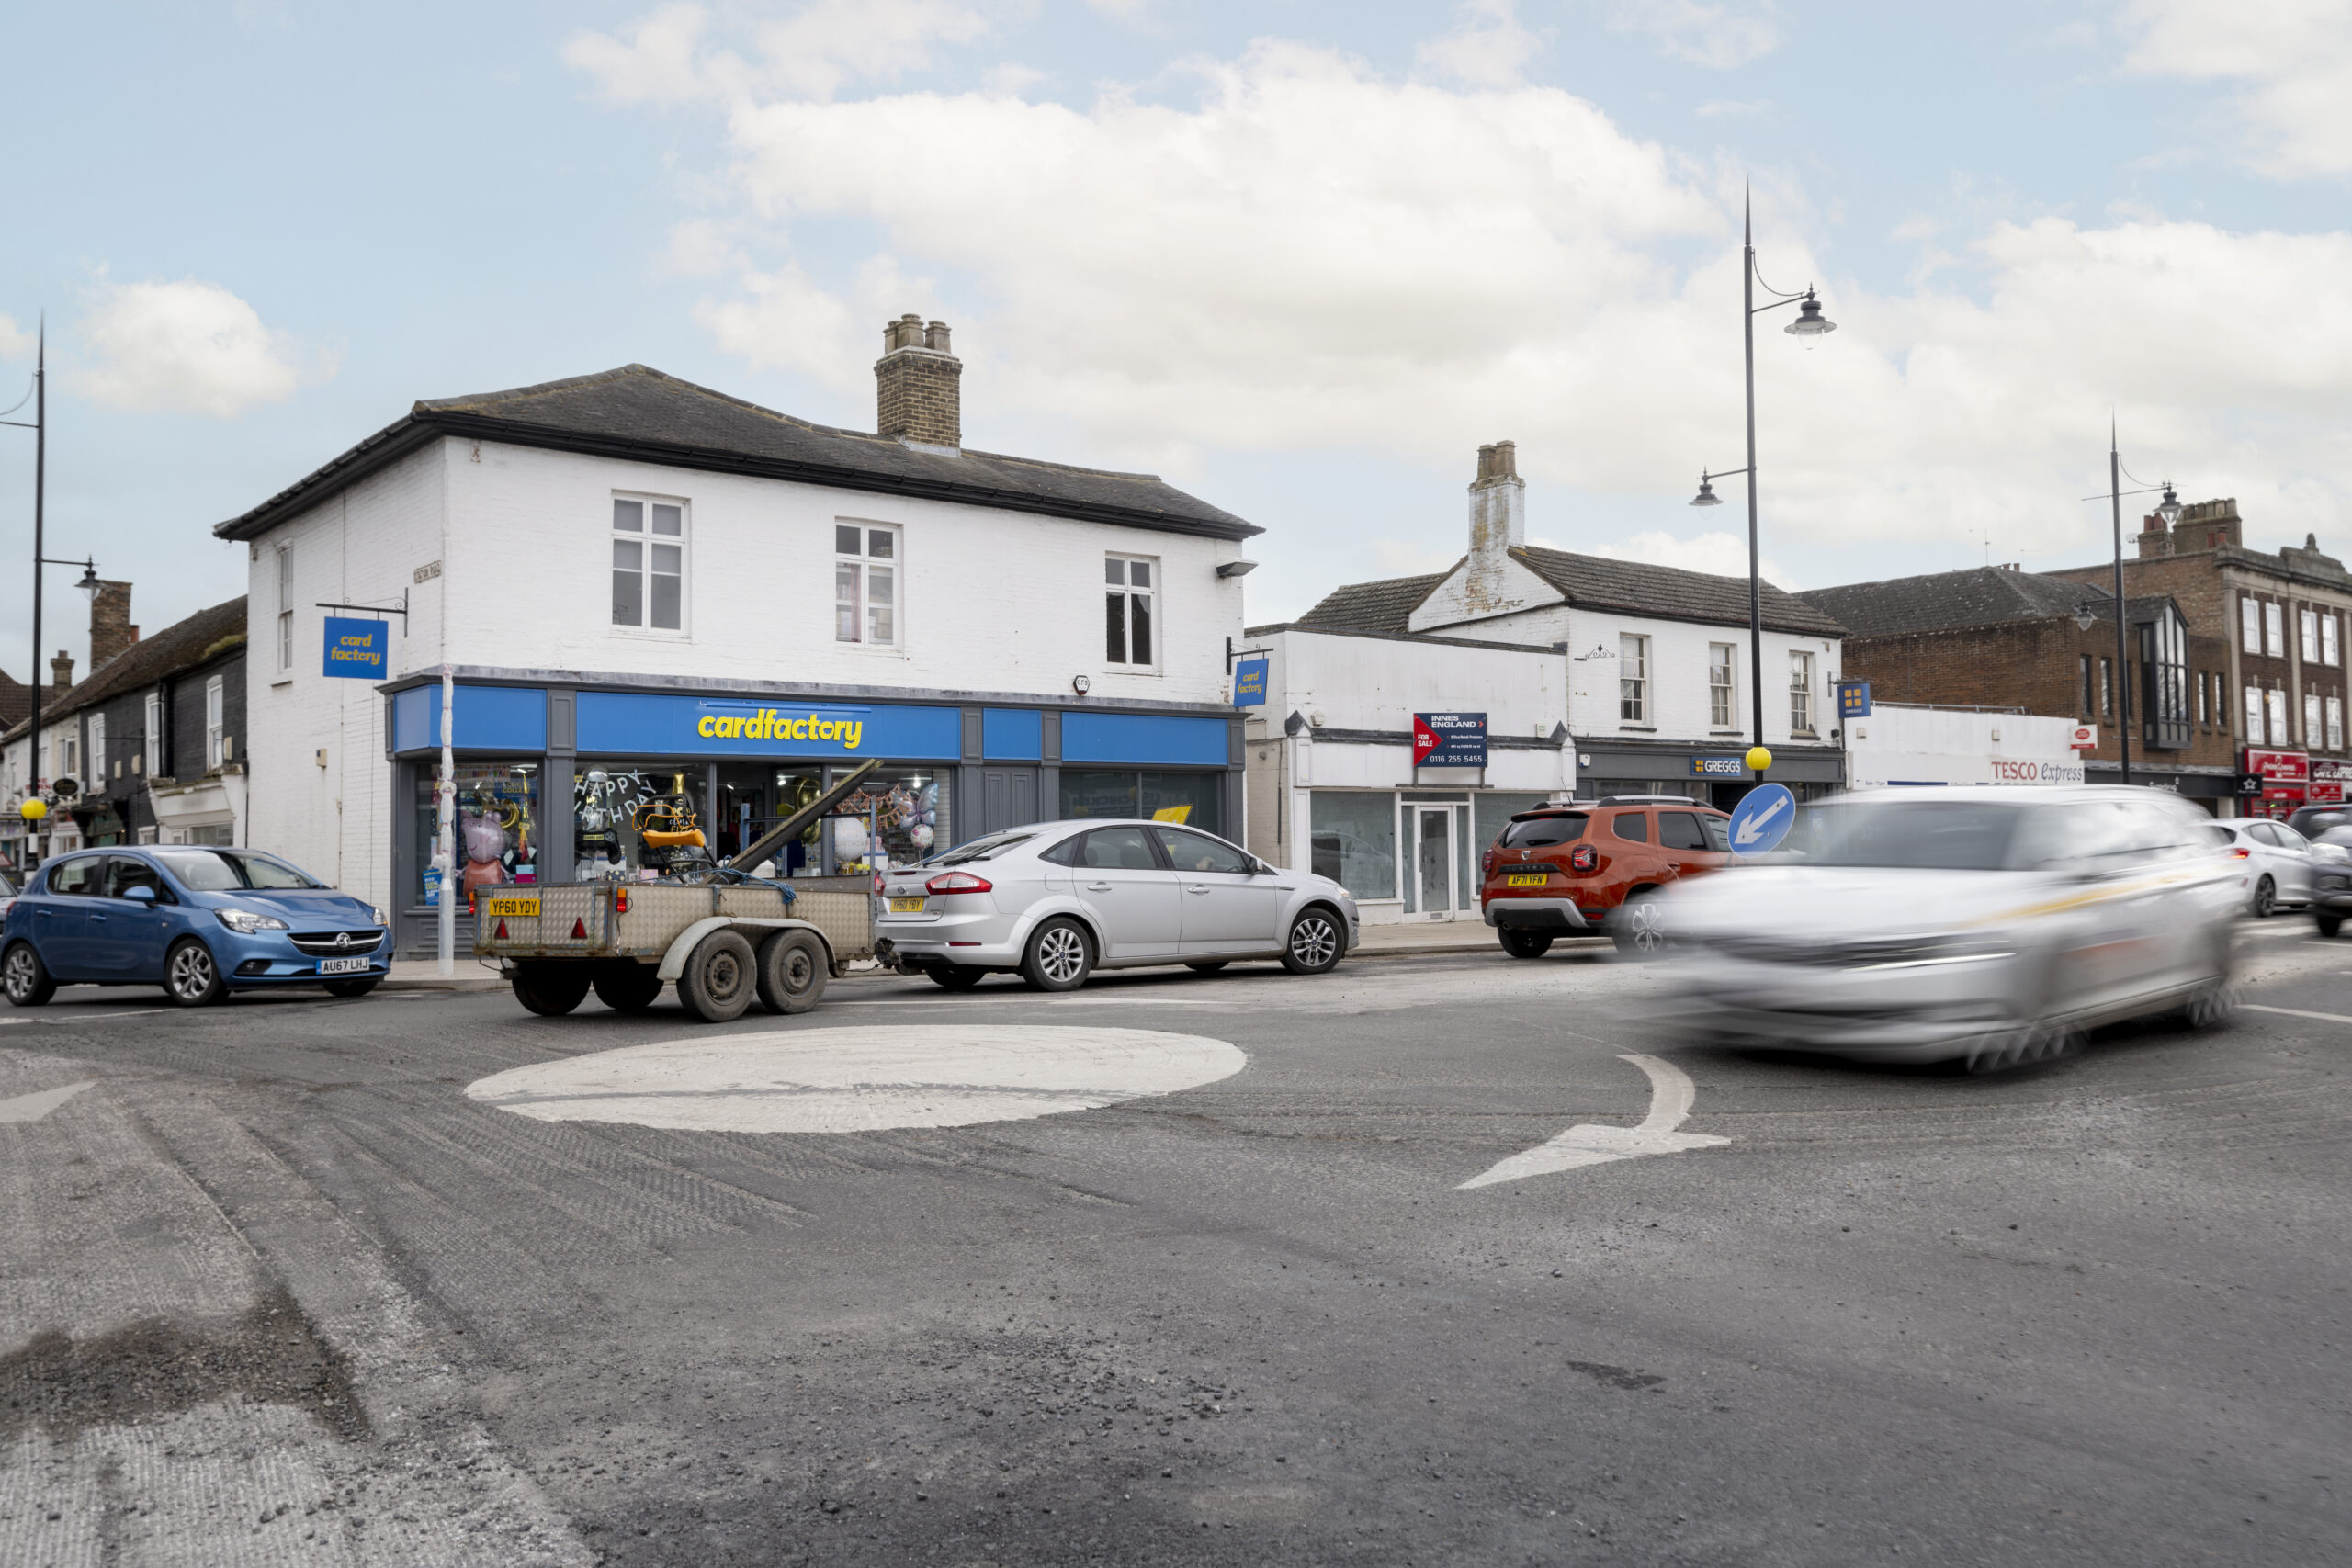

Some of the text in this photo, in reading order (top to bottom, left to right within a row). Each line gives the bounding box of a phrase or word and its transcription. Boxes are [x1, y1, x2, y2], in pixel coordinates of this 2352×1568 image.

[340, 634, 372, 647] card
[331, 647, 380, 665] factory
[1243, 670, 1260, 682] card
[1238, 683, 1262, 694] factory
[698, 708, 863, 749] cardfactory
[1705, 760, 1741, 773] GREGGS
[1992, 761, 2082, 784] TESCO express
[574, 769, 641, 798] HAPPY
[1512, 874, 1543, 884] AF71 YFN
[493, 901, 537, 913] YP60 YDY
[893, 897, 907, 909] YP60
[323, 958, 368, 972] AU67 LHJ
